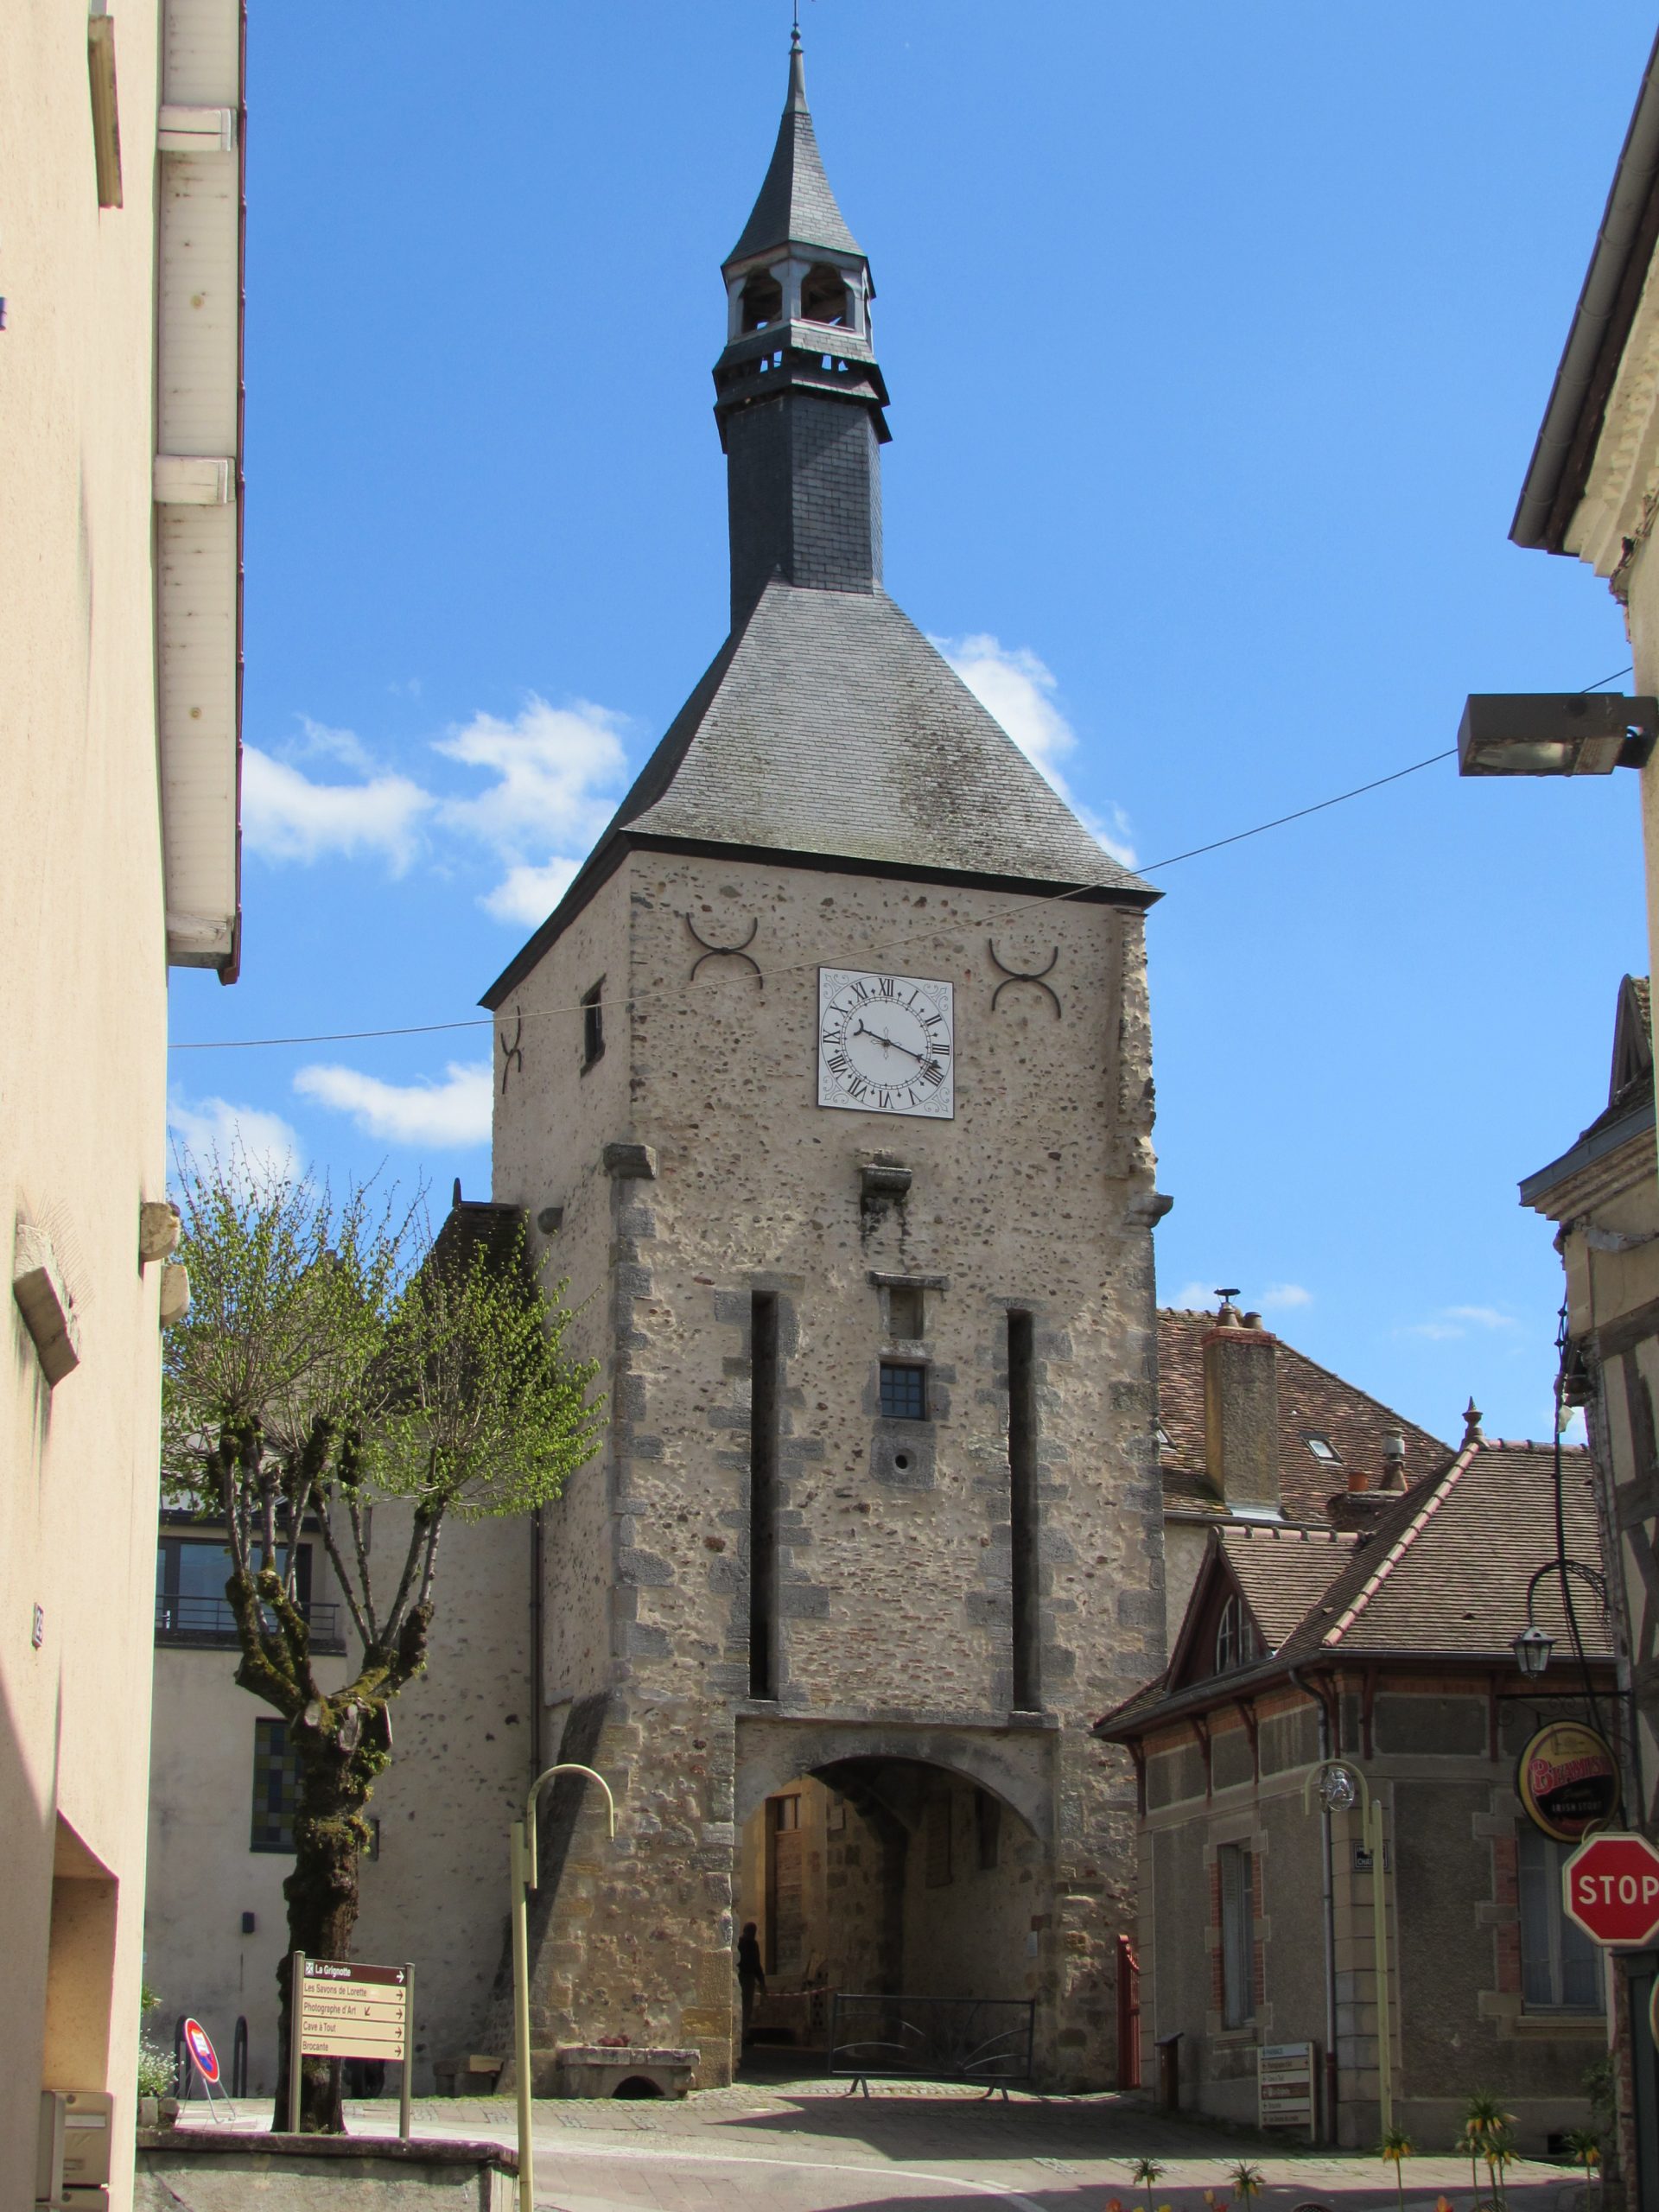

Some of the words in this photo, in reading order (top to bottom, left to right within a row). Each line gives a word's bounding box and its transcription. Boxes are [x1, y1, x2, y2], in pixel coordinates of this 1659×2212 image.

[849, 981, 868, 1003] XI
[878, 977, 894, 997] XII
[830, 1001, 849, 1018] X
[925, 1014, 943, 1027] II
[932, 1043, 950, 1056] III
[847, 1077, 868, 1102] VII
[907, 1087, 922, 1106] V
[1578, 1875, 1659, 1904] STOP
[315, 1964, 323, 1974] La
[324, 1965, 352, 1978] Grignotte
[304, 1983, 315, 1993] Les
[316, 1984, 337, 1994] Savons
[339, 1986, 346, 1995] de
[346, 1986, 367, 1997] Lorette
[303, 2001, 341, 2015] Photographe
[341, 2005, 356, 2015] d'Art
[302, 2020, 318, 2031] Cave
[319, 2023, 323, 2031] à
[323, 2022, 336, 2032] Tout
[302, 2040, 329, 2051] Brocante
